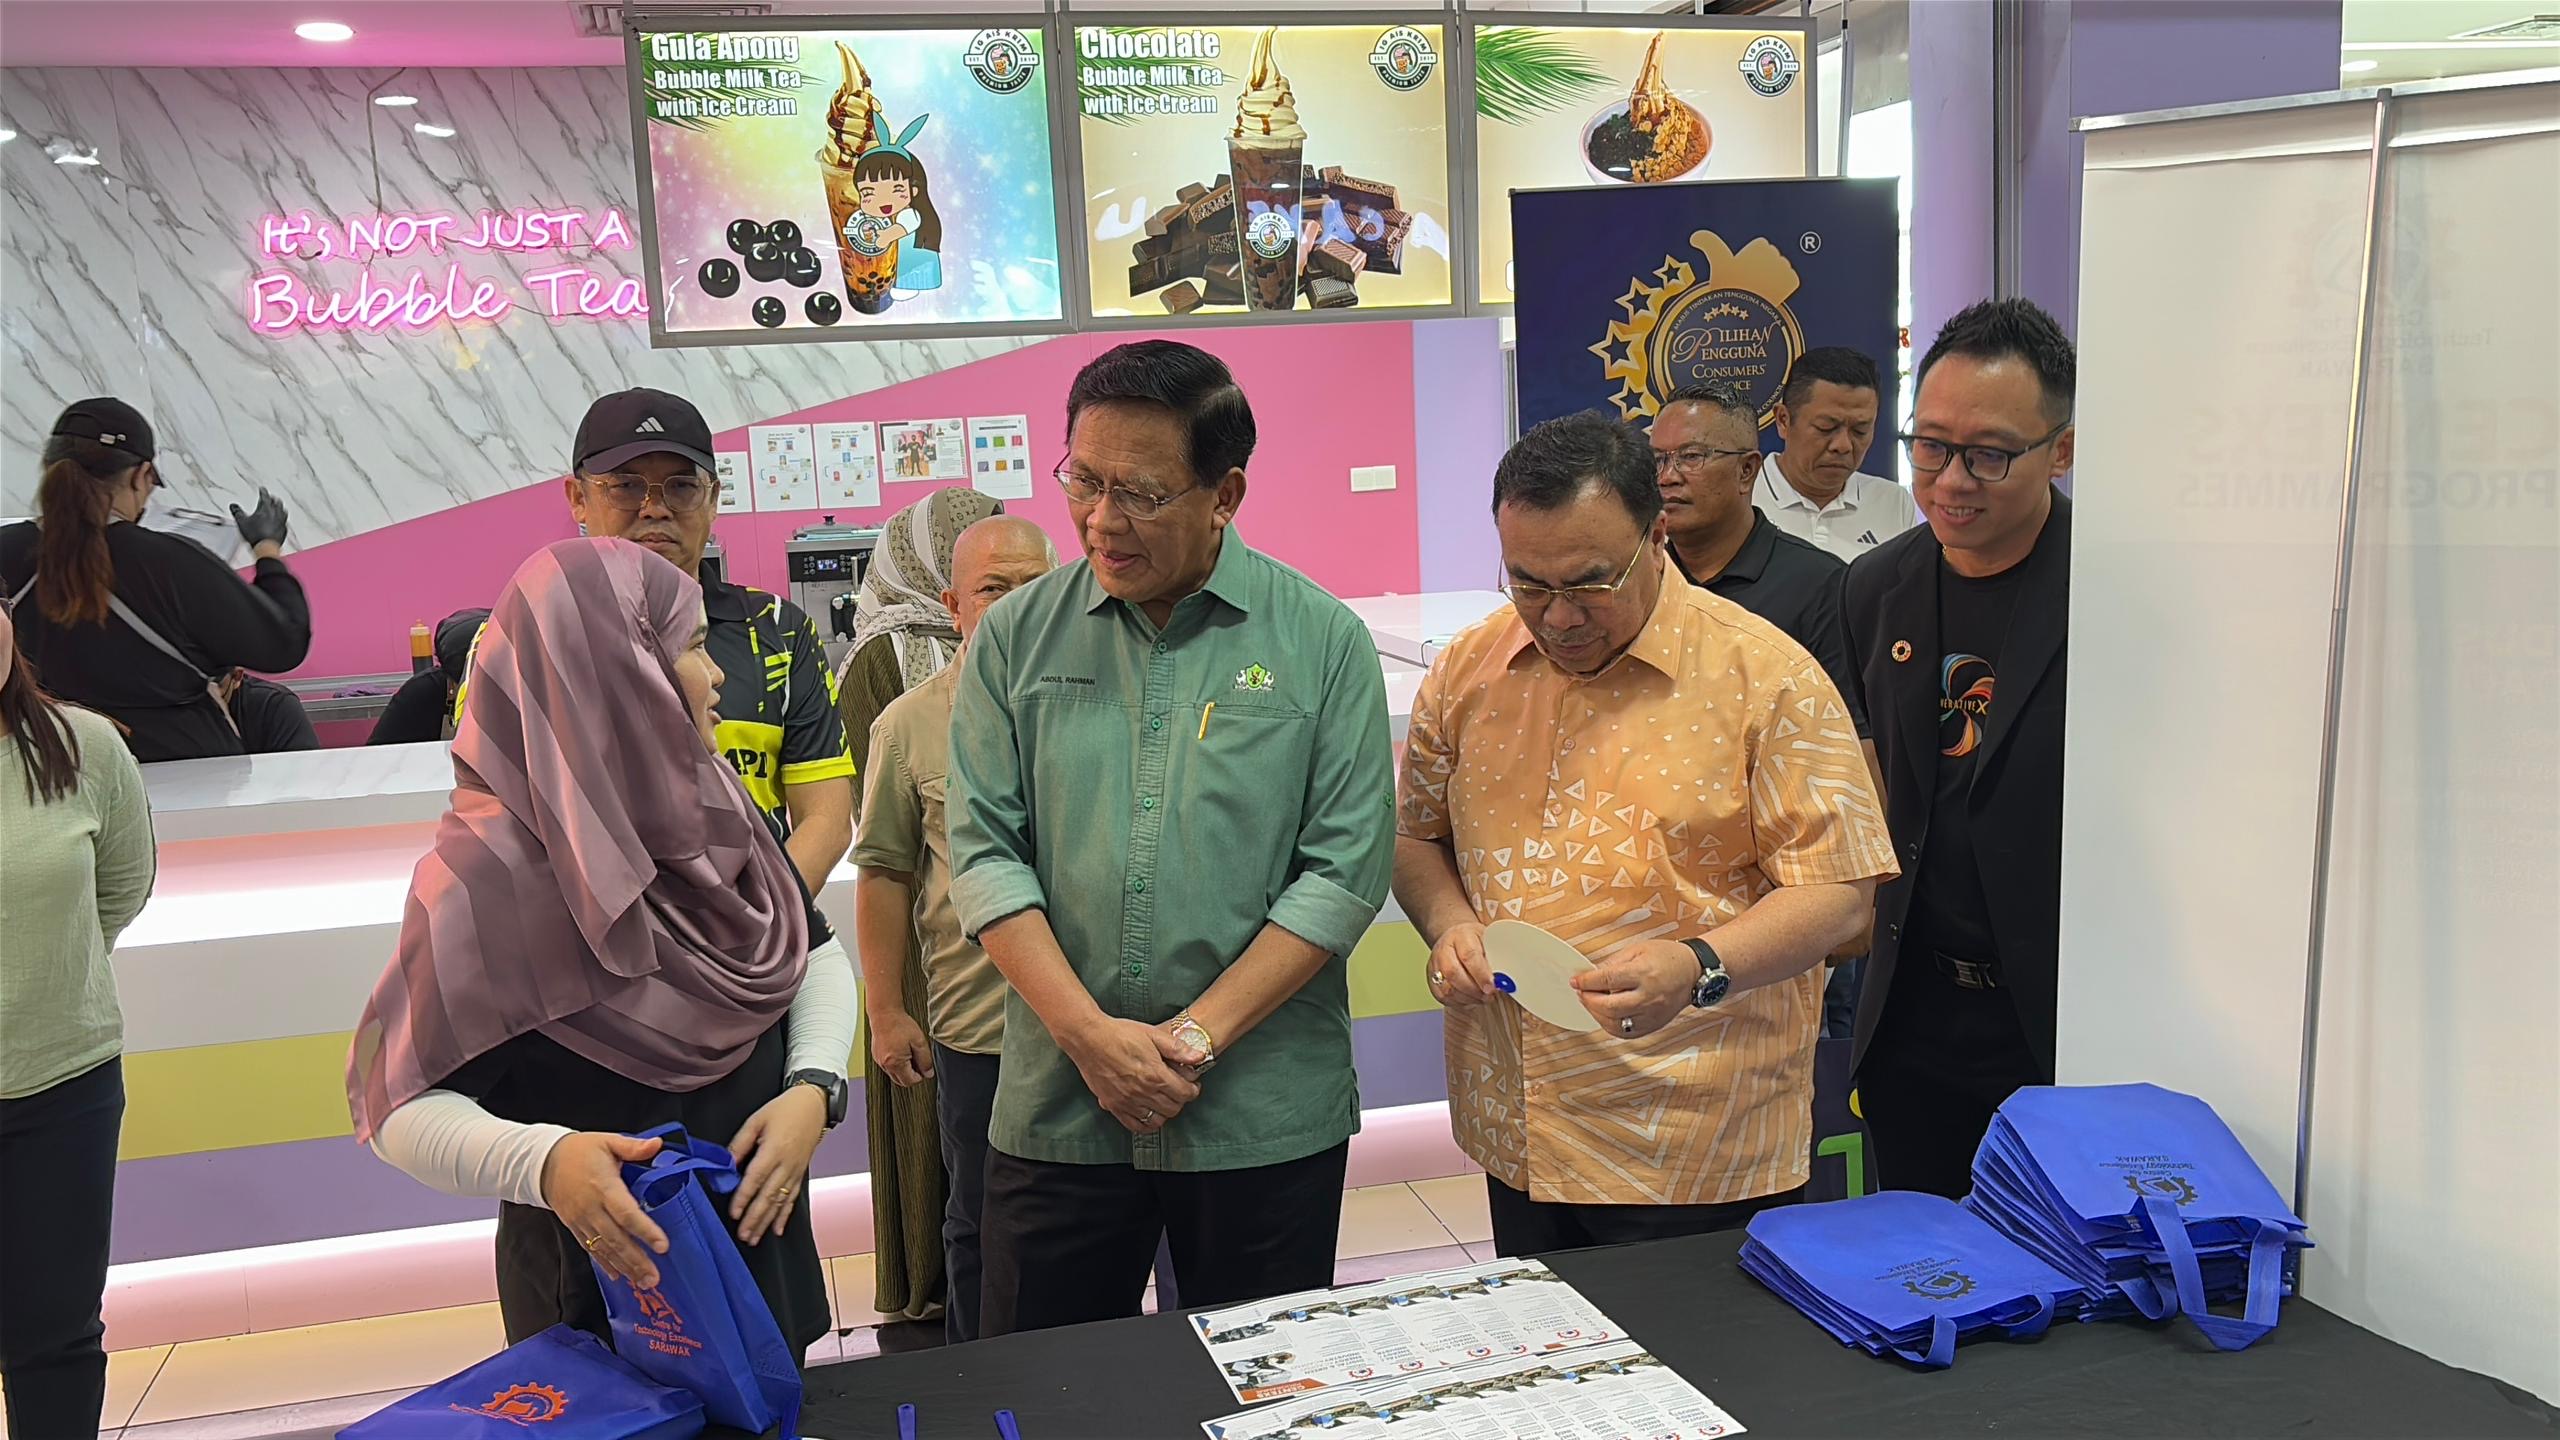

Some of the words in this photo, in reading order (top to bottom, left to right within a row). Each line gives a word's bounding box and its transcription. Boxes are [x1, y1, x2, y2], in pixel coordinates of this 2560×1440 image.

[651, 32, 711, 62] Gula
[717, 32, 800, 63] Apong
[986, 30, 1001, 39] AIS
[1005, 31, 1028, 52] KRIM
[1080, 28, 1221, 58] Chocolate
[1390, 30, 1403, 39] AIS
[1406, 31, 1427, 51] KRIM
[1757, 39, 1770, 48] AIS
[1773, 40, 1791, 59] KRIM
[654, 70, 721, 89] Bubble
[724, 68, 765, 89] Milk
[768, 68, 802, 88] Tea
[1082, 66, 1146, 86] Bubble
[1150, 65, 1188, 86] Milk
[1191, 65, 1223, 86] Tea
[656, 96, 698, 117] with
[701, 97, 732, 116] Ice
[735, 96, 797, 115] Cream
[1084, 94, 1124, 114] with
[1125, 94, 1155, 114] Ice
[1158, 93, 1218, 114] Cream
[264, 216, 332, 257] It's
[348, 215, 454, 255] NOT
[461, 212, 585, 249] JUST
[594, 210, 630, 247] A
[252, 263, 507, 328] Bubble
[526, 268, 650, 318] Tea
[1724, 291, 1760, 305] PENGGUNA
[1065, 676, 1096, 686] RAHMAN
[649, 1340, 691, 1357] SARAWAK
